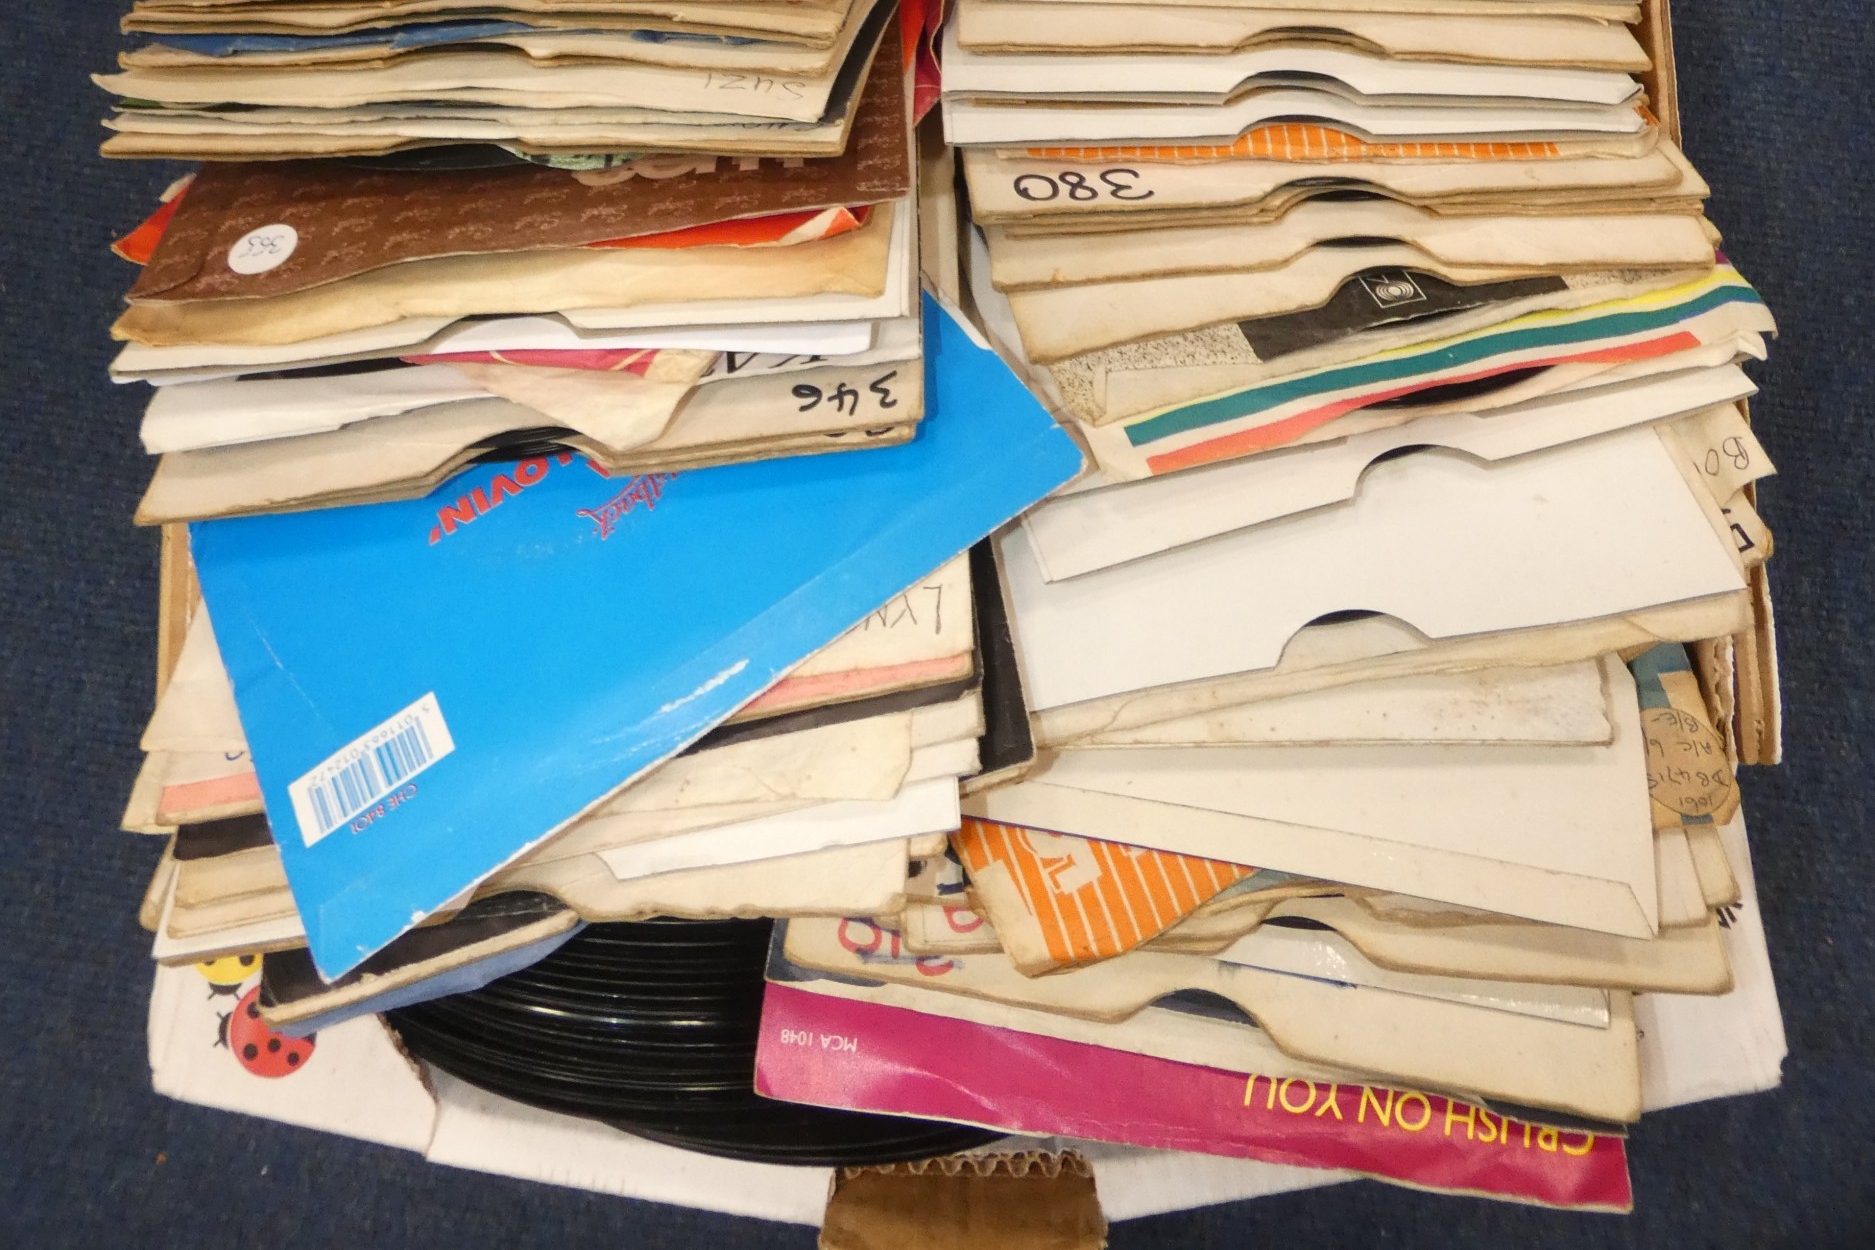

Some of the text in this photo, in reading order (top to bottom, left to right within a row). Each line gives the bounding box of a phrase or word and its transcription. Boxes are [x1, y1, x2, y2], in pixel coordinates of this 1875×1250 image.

[1013, 169, 1154, 202] 380
[791, 370, 898, 417] 346
[1693, 437, 1750, 477] BO
[780, 1028, 858, 1054] MCA 1048
[1244, 1073, 1343, 1122] YOU
[1358, 1085, 1431, 1131] ON
